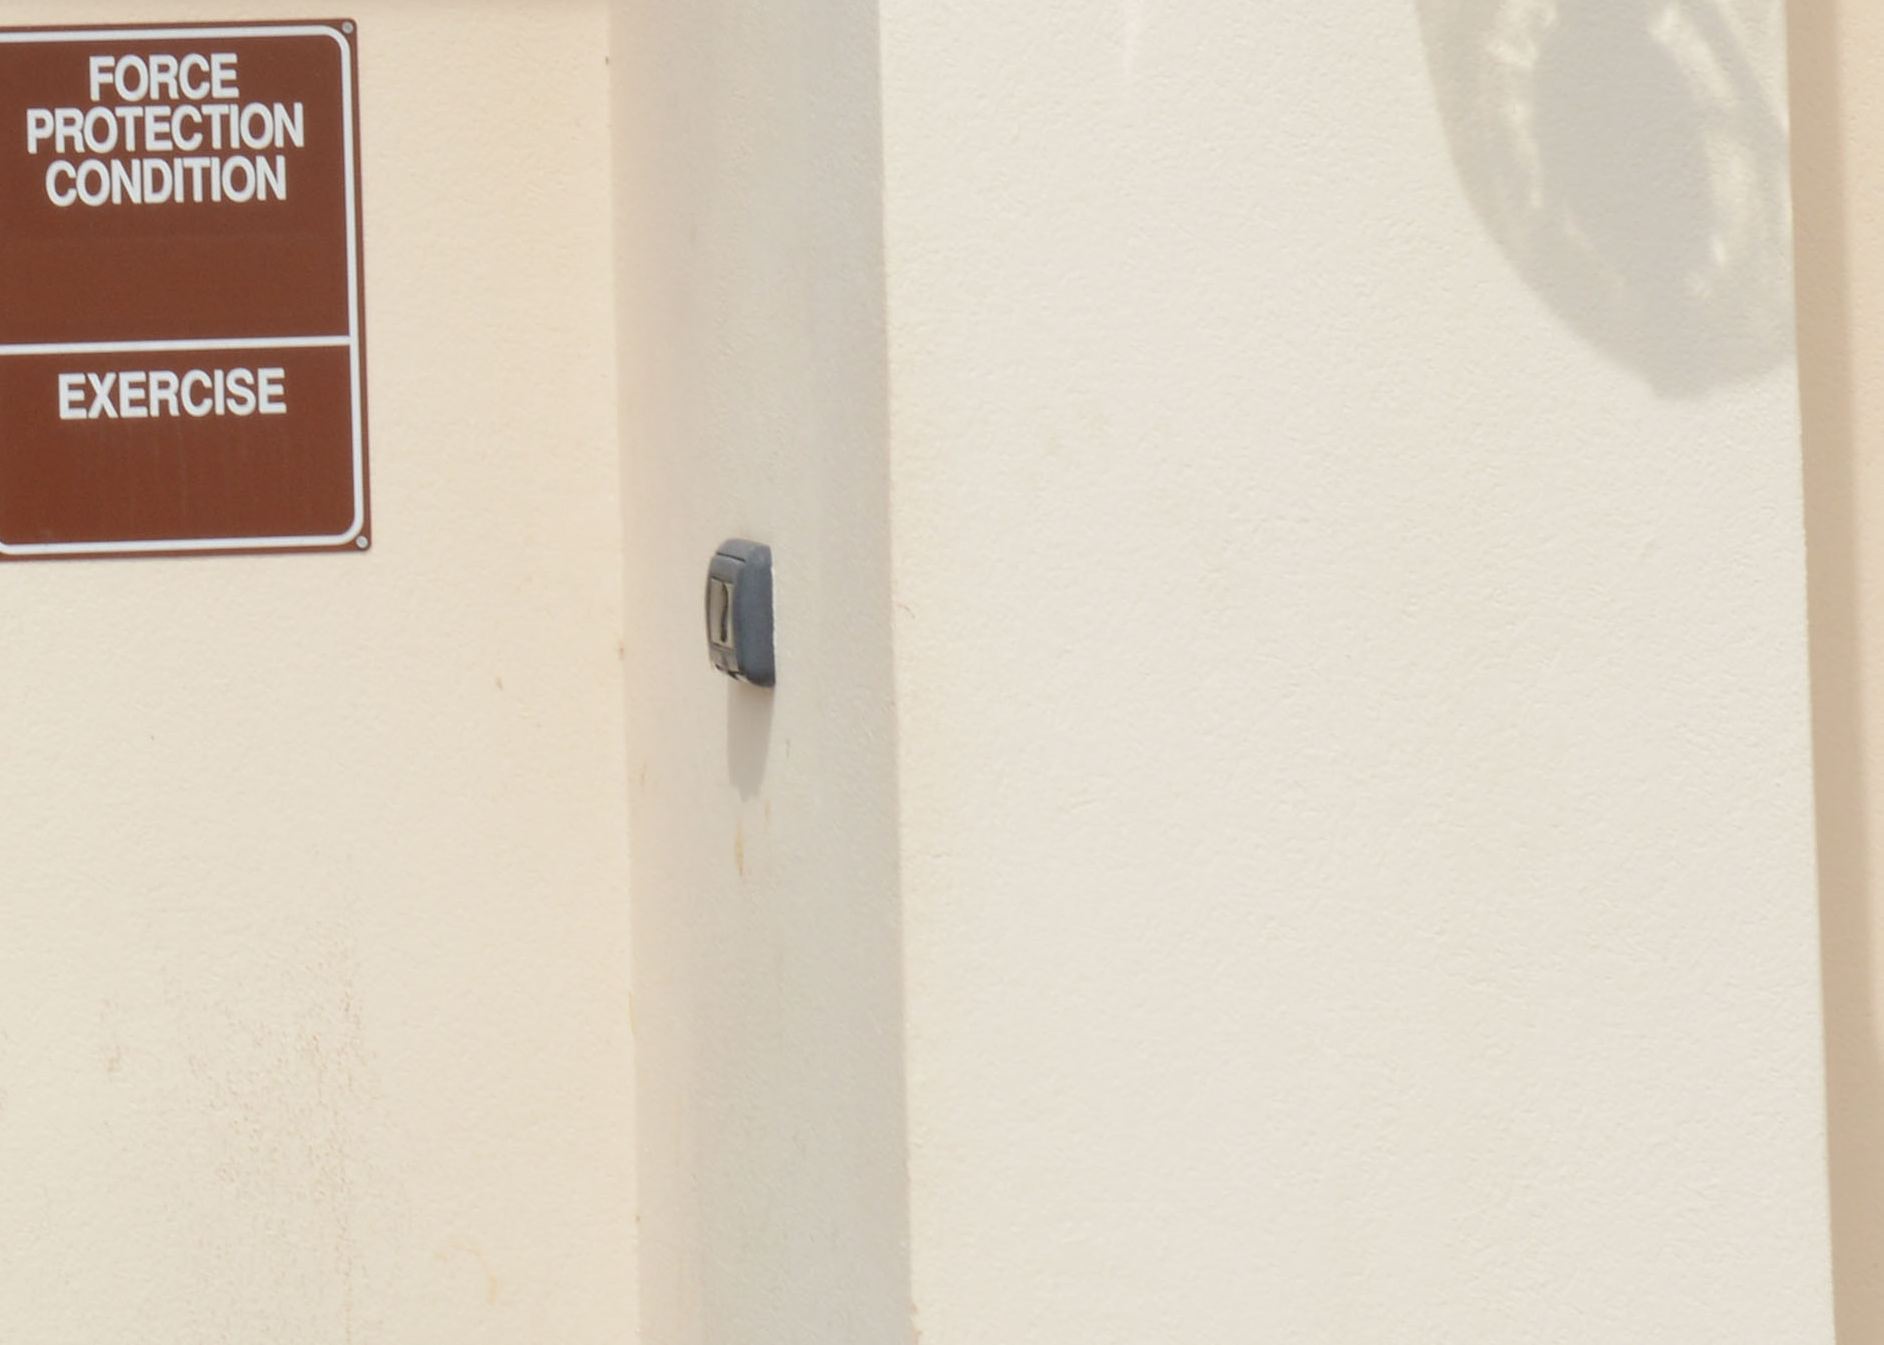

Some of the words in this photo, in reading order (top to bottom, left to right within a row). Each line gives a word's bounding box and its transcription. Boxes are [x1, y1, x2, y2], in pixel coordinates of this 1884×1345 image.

[88, 53, 240, 102] FORCE
[25, 101, 306, 155] PROTECTION
[44, 154, 288, 207] CONDITION
[56, 367, 288, 421] EXERCISE
